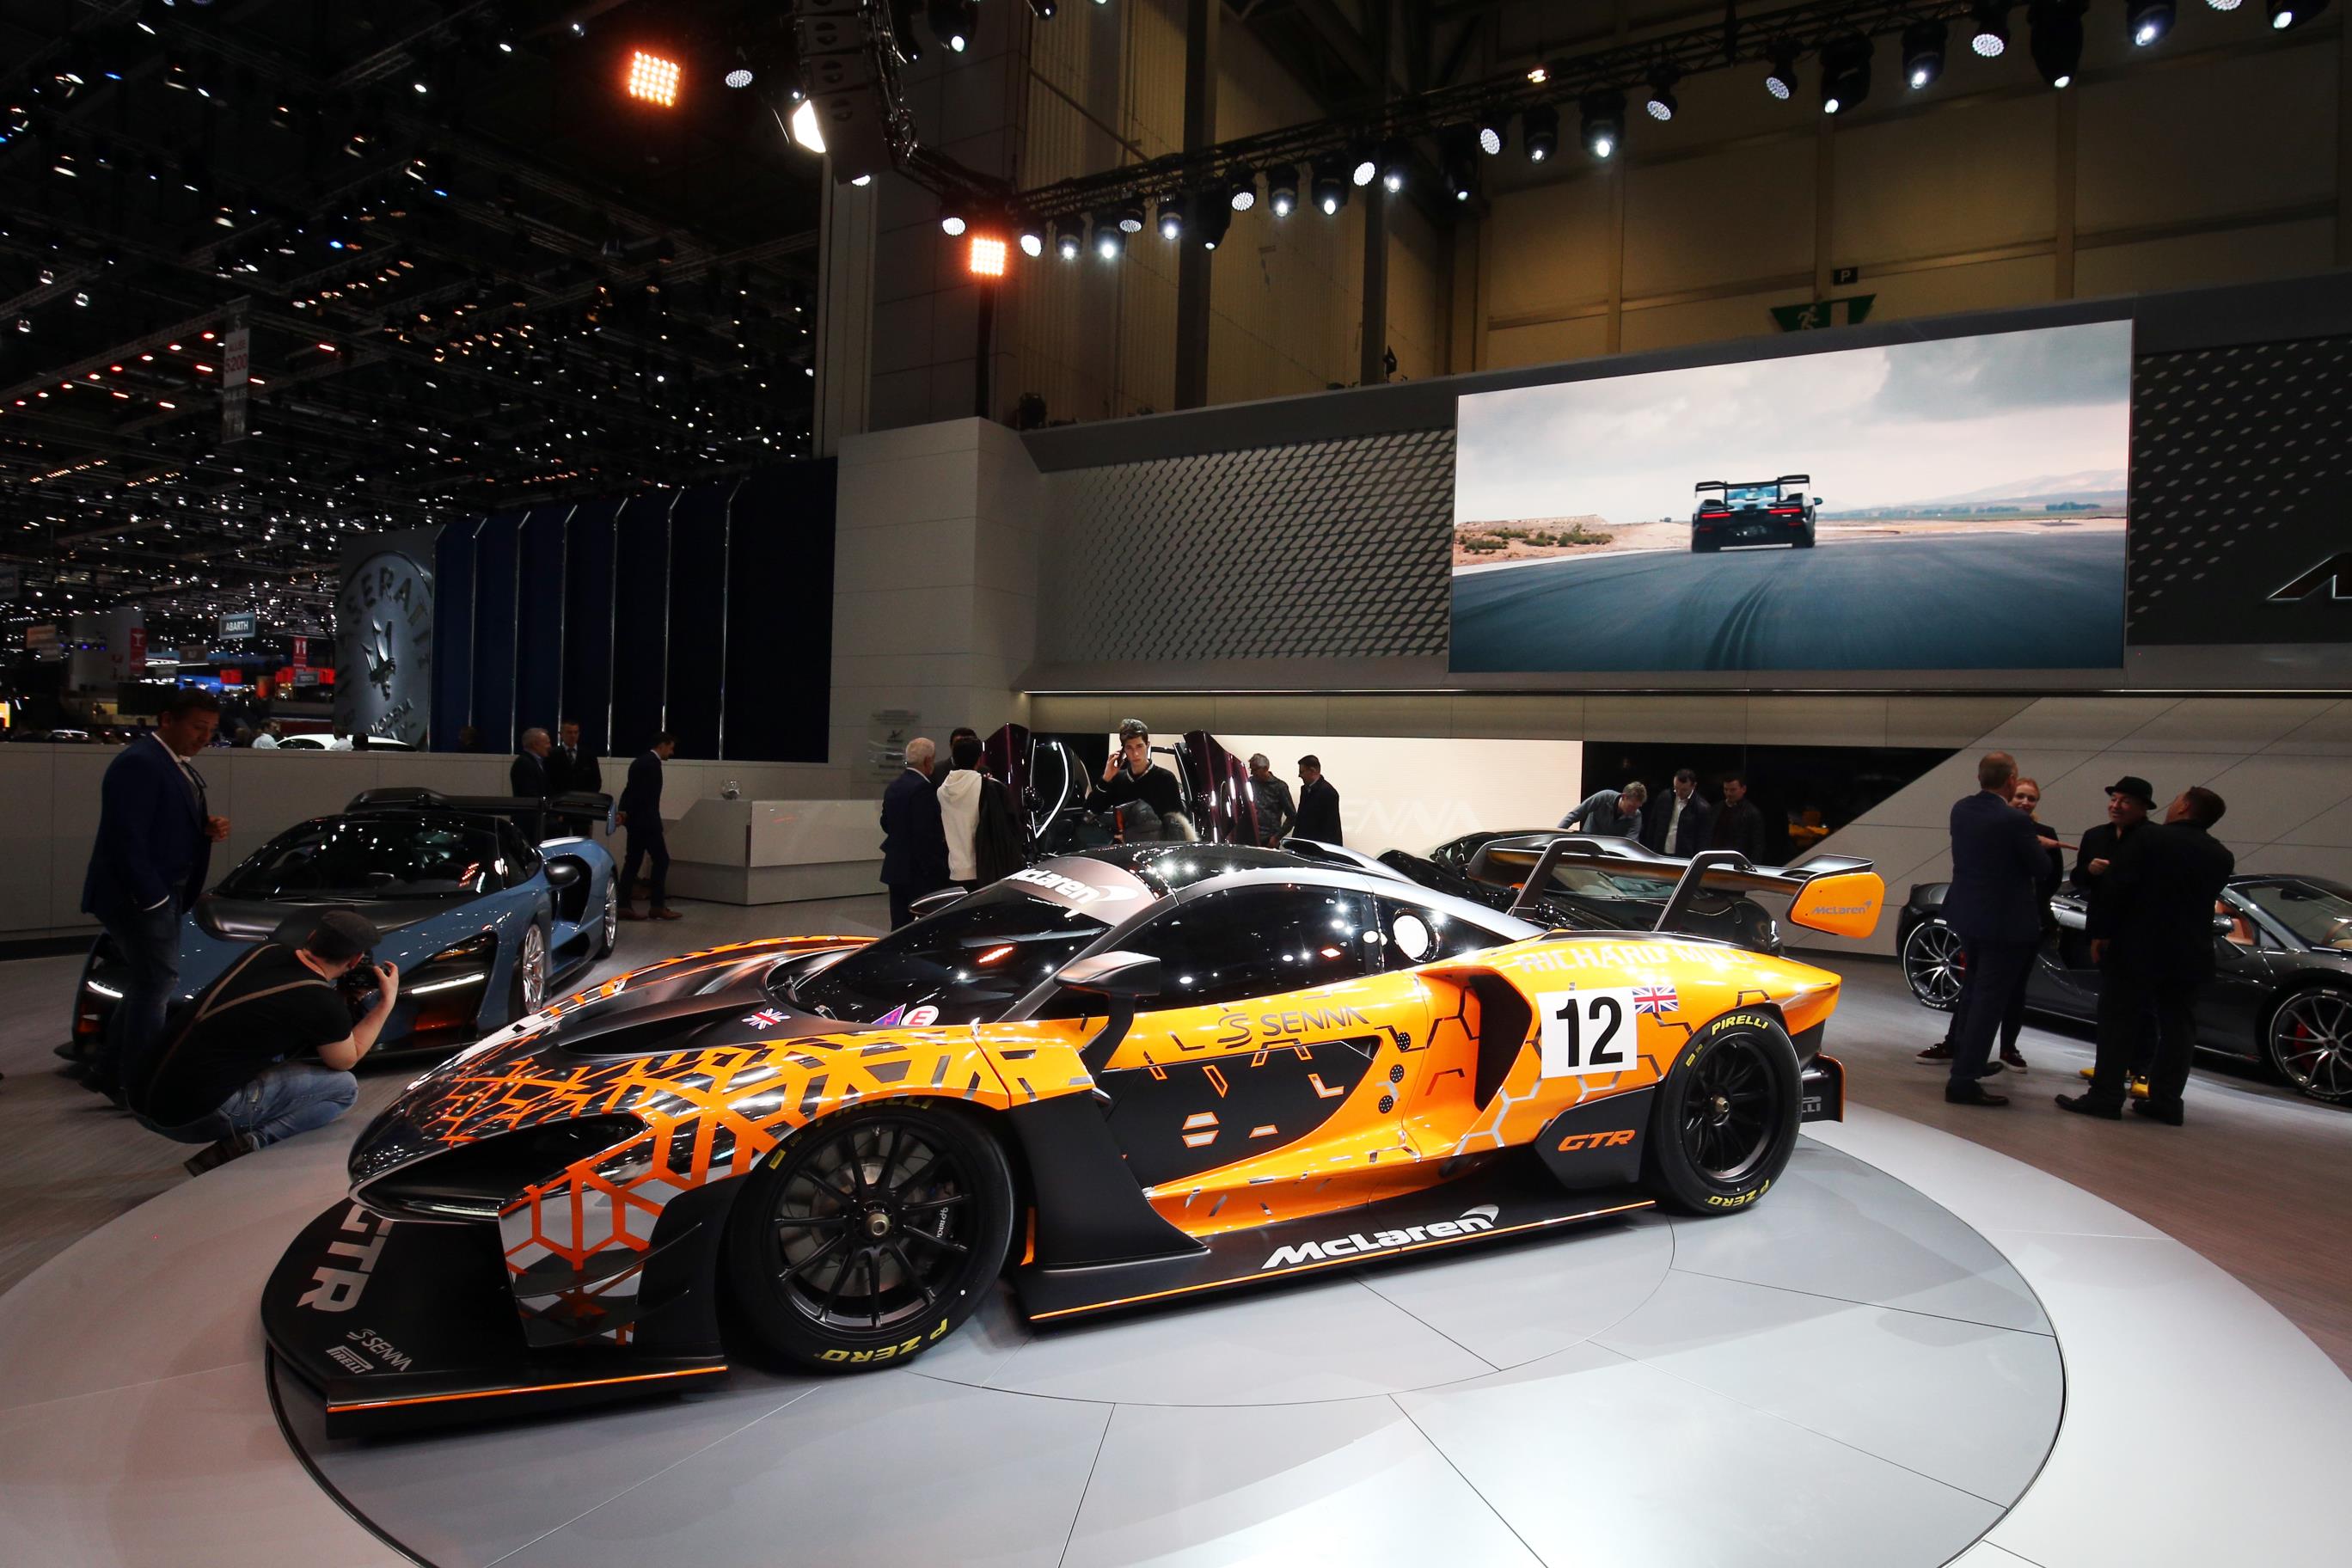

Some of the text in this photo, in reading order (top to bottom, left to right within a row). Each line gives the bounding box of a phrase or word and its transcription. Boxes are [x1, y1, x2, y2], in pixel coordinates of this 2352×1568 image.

[1841, 270, 1851, 282] P
[225, 621, 249, 632] ABARTH
[1341, 798, 1485, 837] ENNA
[1811, 905, 1866, 915] McLaren
[1519, 945, 1670, 973] RICHARD
[1260, 1004, 1370, 1037] SENNA
[1555, 996, 1624, 1068] 12
[1711, 1014, 1769, 1037] PIRELLI
[1558, 1130, 1636, 1152] GTR
[1707, 1179, 1770, 1207] P ZERO
[1261, 1216, 1495, 1270] McLaren
[360, 1337, 413, 1372] SENNA
[820, 1318, 948, 1363] P ZERO
[325, 1344, 375, 1375] PIRELLI
